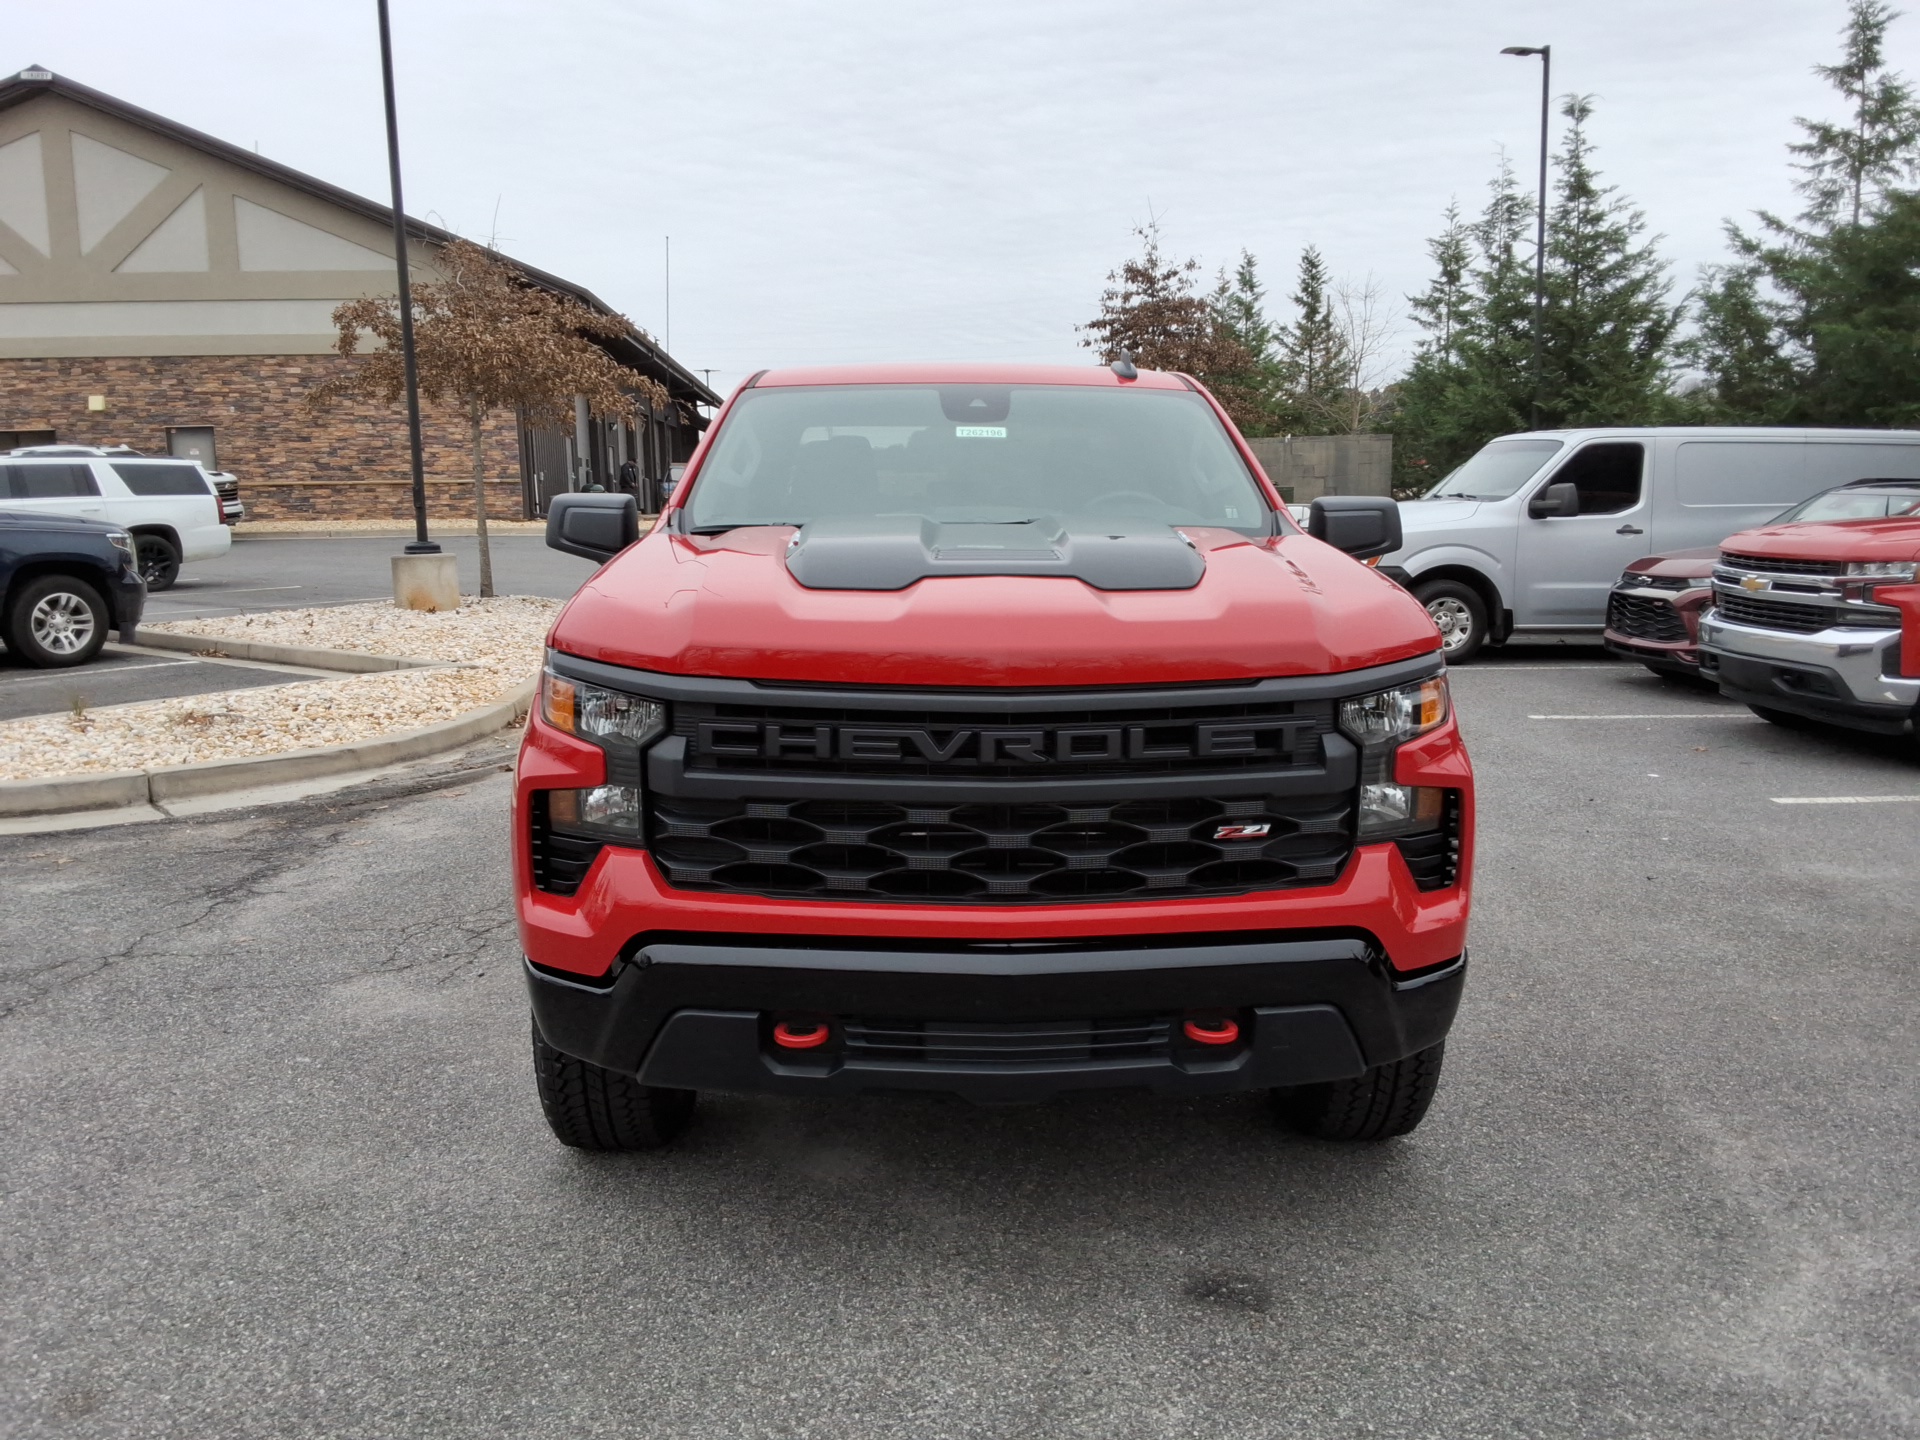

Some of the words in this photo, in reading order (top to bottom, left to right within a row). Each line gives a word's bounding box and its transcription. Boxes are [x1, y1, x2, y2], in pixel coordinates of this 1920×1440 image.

[960, 428, 1003, 437] T262196
[698, 719, 1317, 762] CHEVROLET
[1213, 823, 1271, 839] Z71
